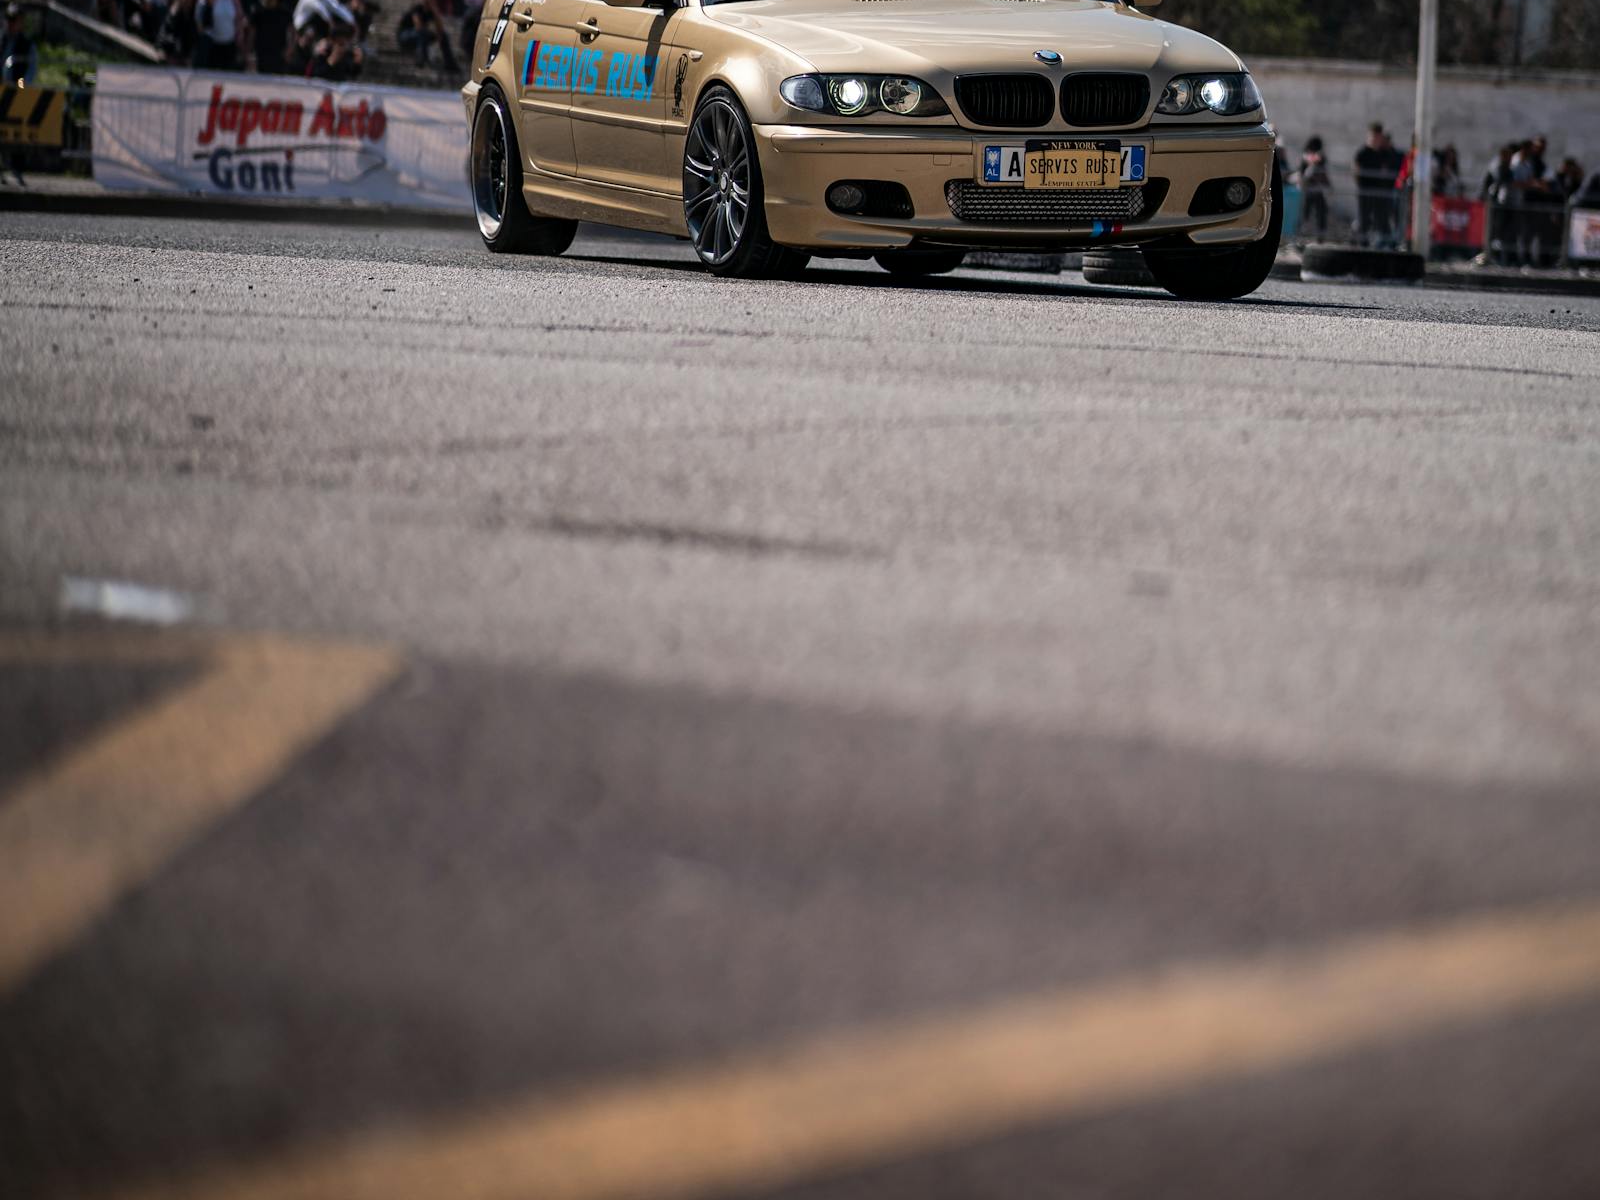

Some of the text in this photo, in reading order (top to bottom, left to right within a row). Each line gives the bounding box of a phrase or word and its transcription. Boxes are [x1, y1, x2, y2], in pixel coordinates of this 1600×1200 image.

[535, 43, 660, 104] SERVIS RUSI
[197, 83, 386, 146] Japan Auto
[1051, 141, 1097, 150] NEW YORK
[209, 148, 295, 191] Goni
[986, 168, 999, 177] AL
[1008, 151, 1022, 177] A
[1030, 158, 1116, 174] SERVIS RUSI
